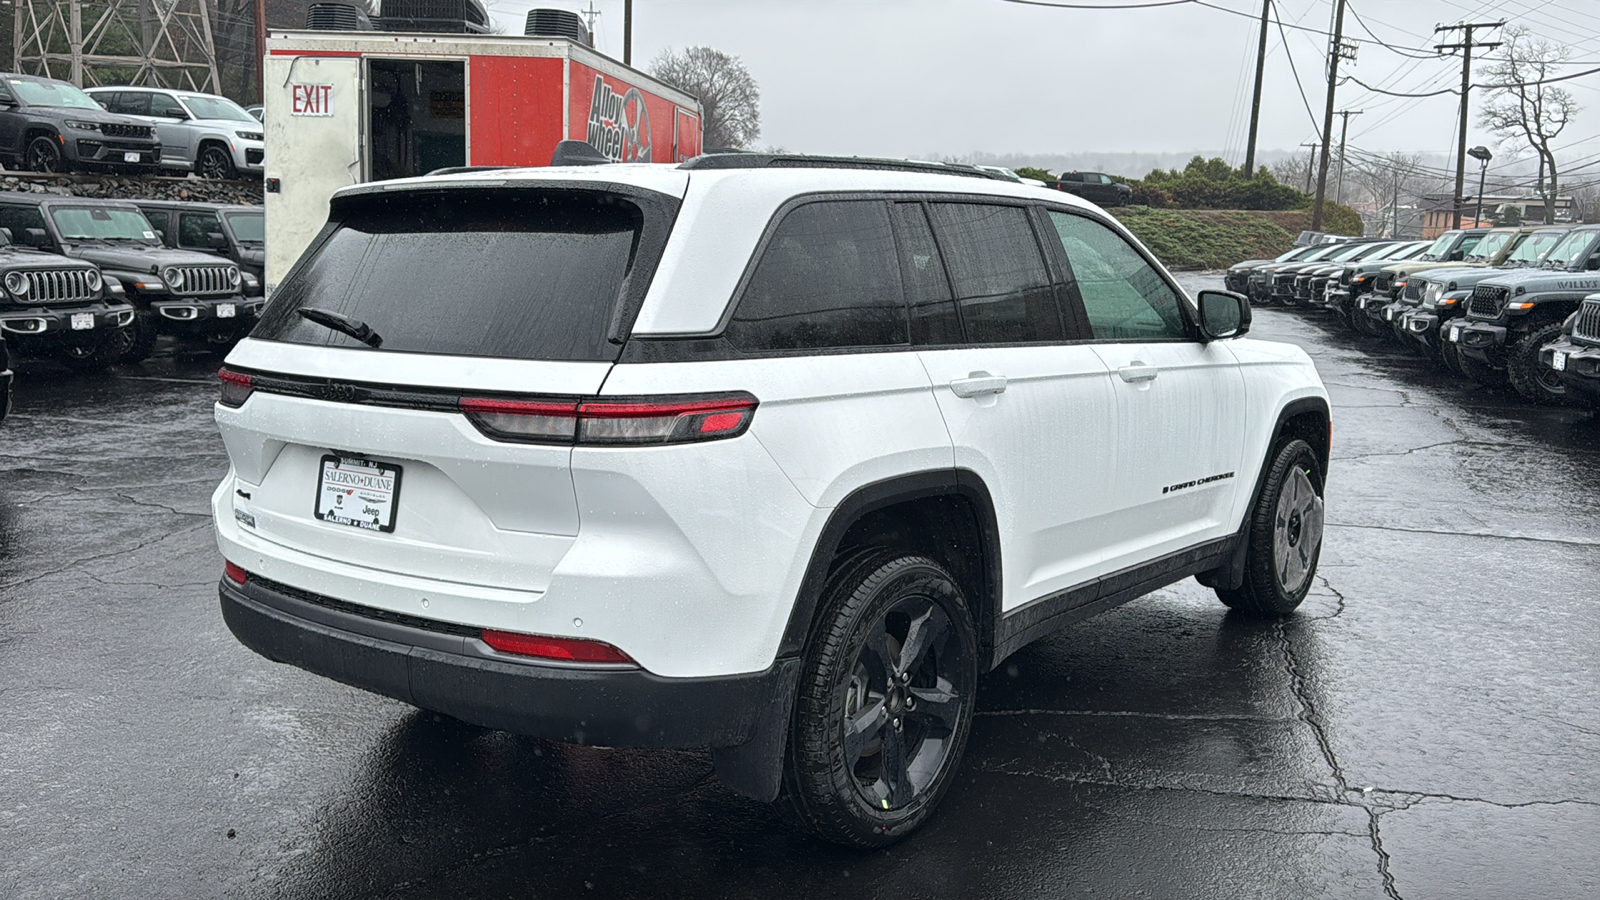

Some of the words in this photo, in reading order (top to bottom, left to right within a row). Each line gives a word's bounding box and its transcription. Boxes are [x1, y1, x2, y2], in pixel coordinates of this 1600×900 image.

[293, 85, 332, 113] EXIT
[588, 74, 623, 127] Alloy
[1557, 280, 1598, 289] WILLYS
[368, 461, 378, 469] NJ
[325, 470, 360, 485] SALERNO
[363, 476, 392, 491] DUANE
[1170, 480, 1196, 491] GRAND
[1197, 471, 1235, 485] CHEROKEE
[362, 504, 380, 517] Jeep
[323, 514, 352, 526] SALERNO
[360, 520, 381, 531] DUANE
